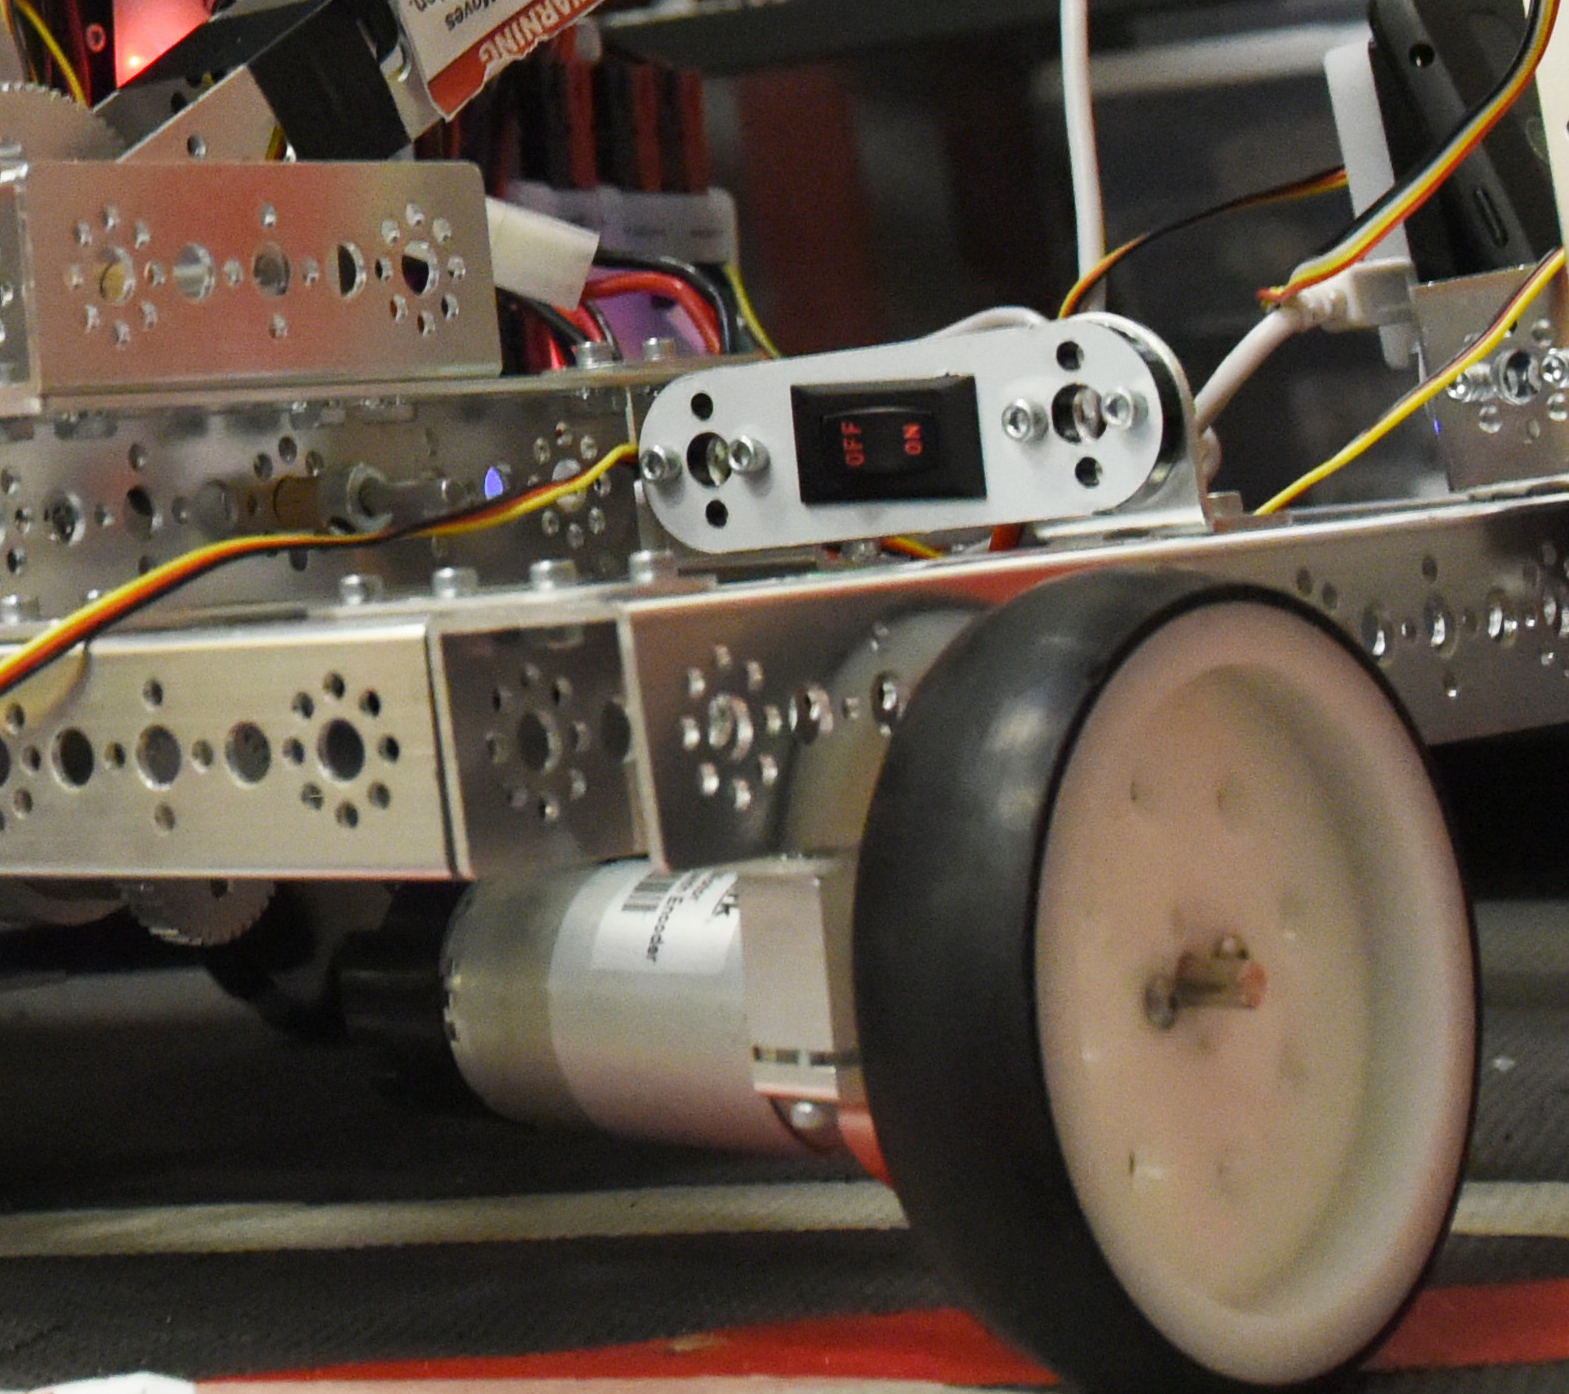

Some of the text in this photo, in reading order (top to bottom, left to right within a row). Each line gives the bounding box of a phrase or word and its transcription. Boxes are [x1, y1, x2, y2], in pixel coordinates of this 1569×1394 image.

[841, 422, 865, 467] OFF
[904, 423, 923, 456] ON
[646, 896, 684, 962] Encoder
